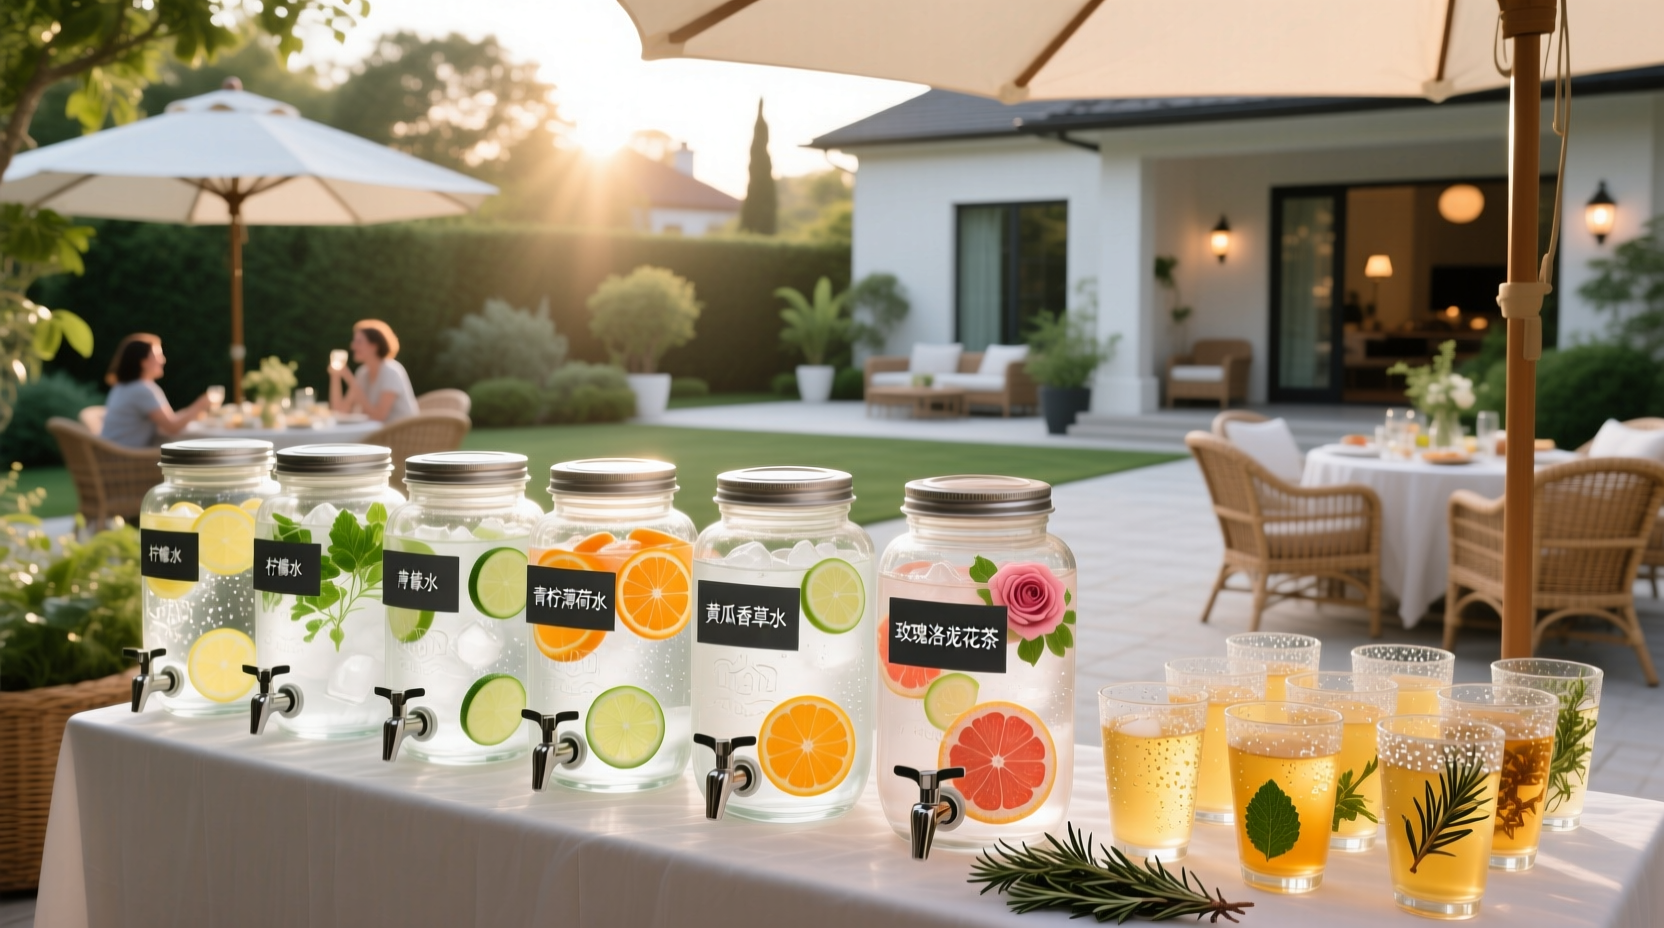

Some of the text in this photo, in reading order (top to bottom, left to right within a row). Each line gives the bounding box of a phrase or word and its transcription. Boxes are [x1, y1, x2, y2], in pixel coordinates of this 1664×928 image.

[705, 600, 787, 629] 黄瓜香草水
